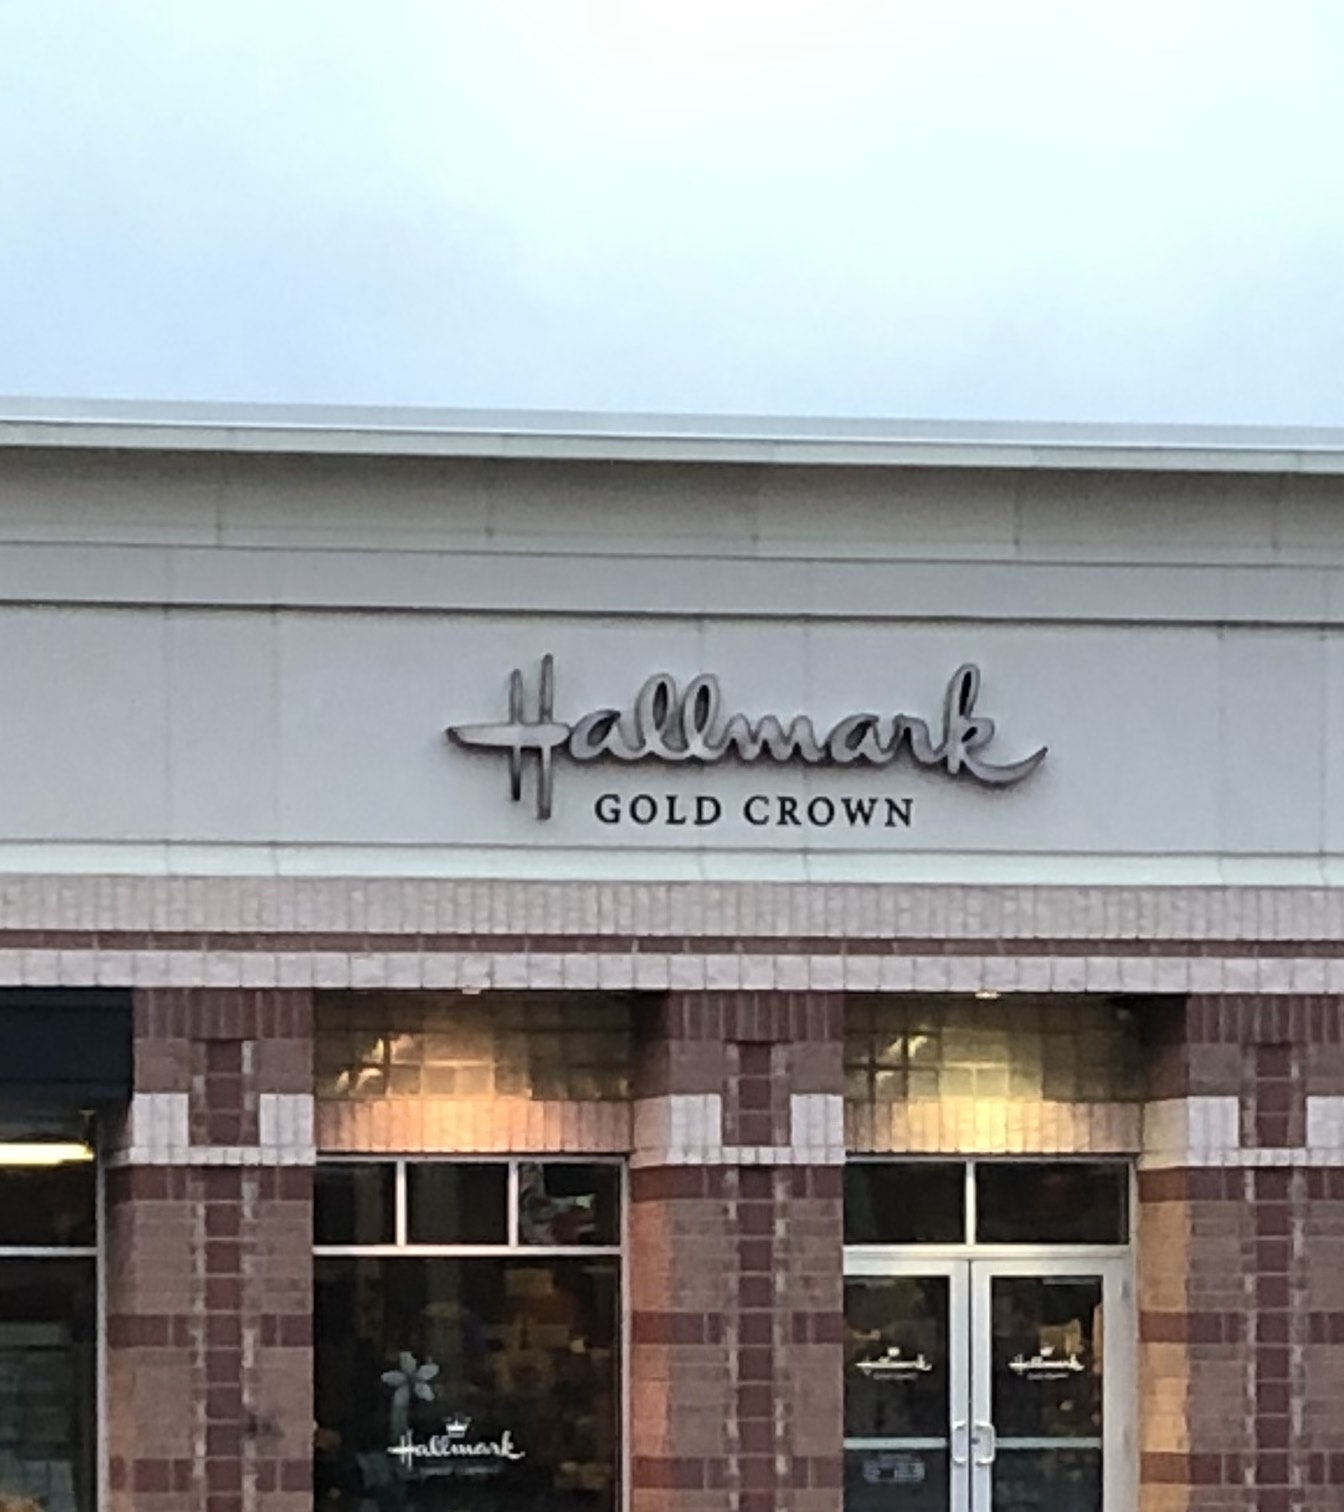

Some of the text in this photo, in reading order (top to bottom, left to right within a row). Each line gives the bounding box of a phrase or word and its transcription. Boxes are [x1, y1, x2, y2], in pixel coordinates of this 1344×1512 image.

[444, 653, 1049, 821] Hallmark
[594, 793, 914, 828] GOLD CROWN
[387, 1429, 526, 1471] Hallmark
